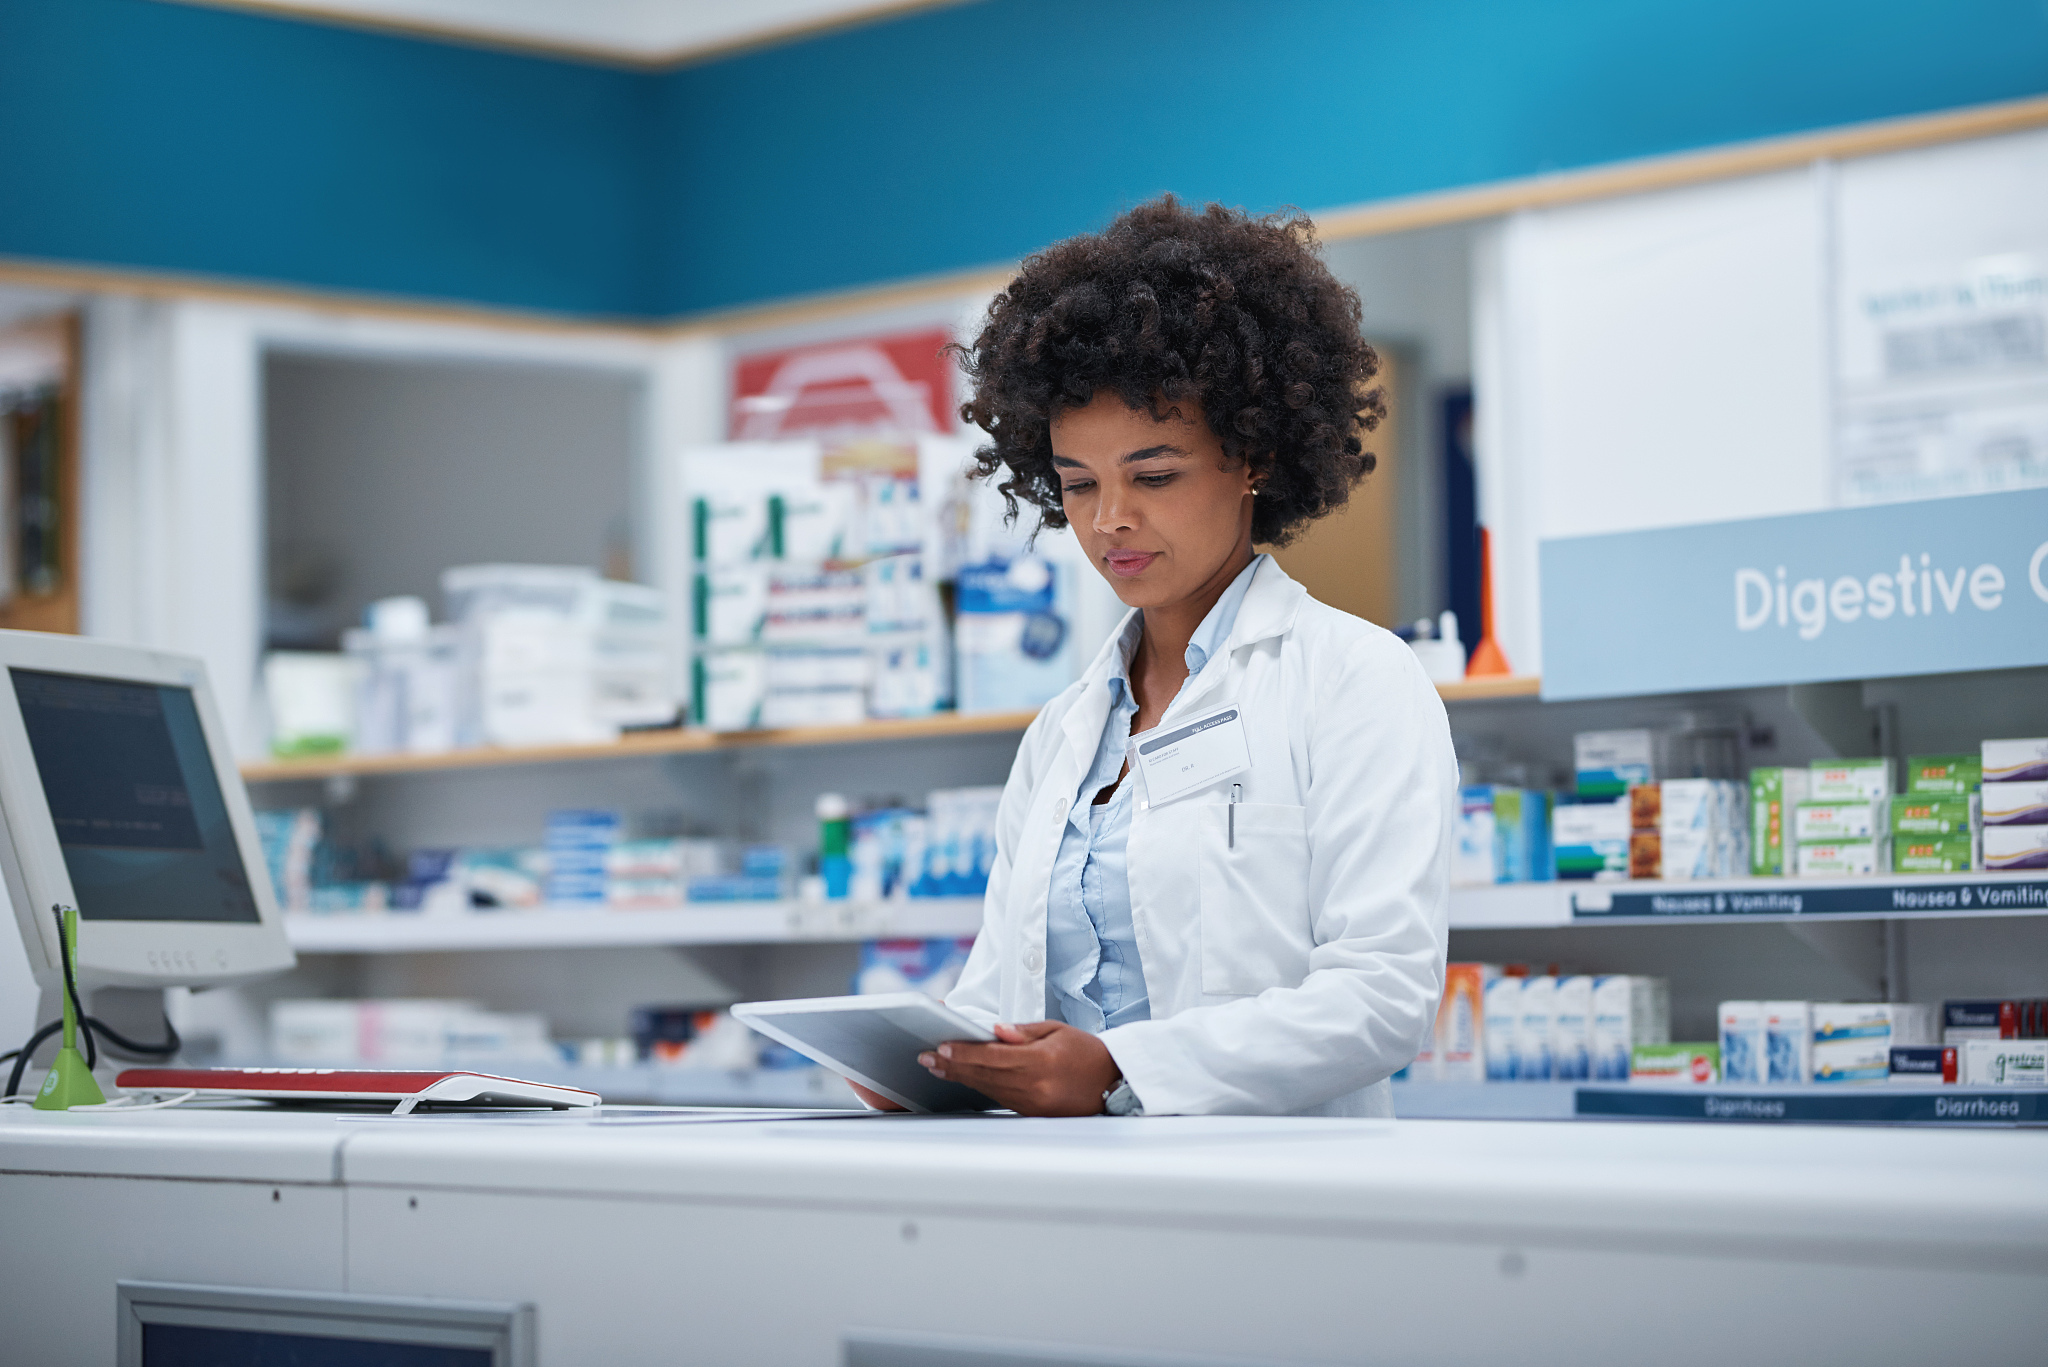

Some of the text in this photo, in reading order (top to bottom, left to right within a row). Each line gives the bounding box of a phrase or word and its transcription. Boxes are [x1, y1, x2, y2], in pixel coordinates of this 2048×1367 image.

[1735, 552, 2005, 640] Digestive
[1892, 888, 1957, 908] Nausea
[1960, 886, 1972, 906] &
[1935, 1097, 2019, 1117] Diarrhoea
